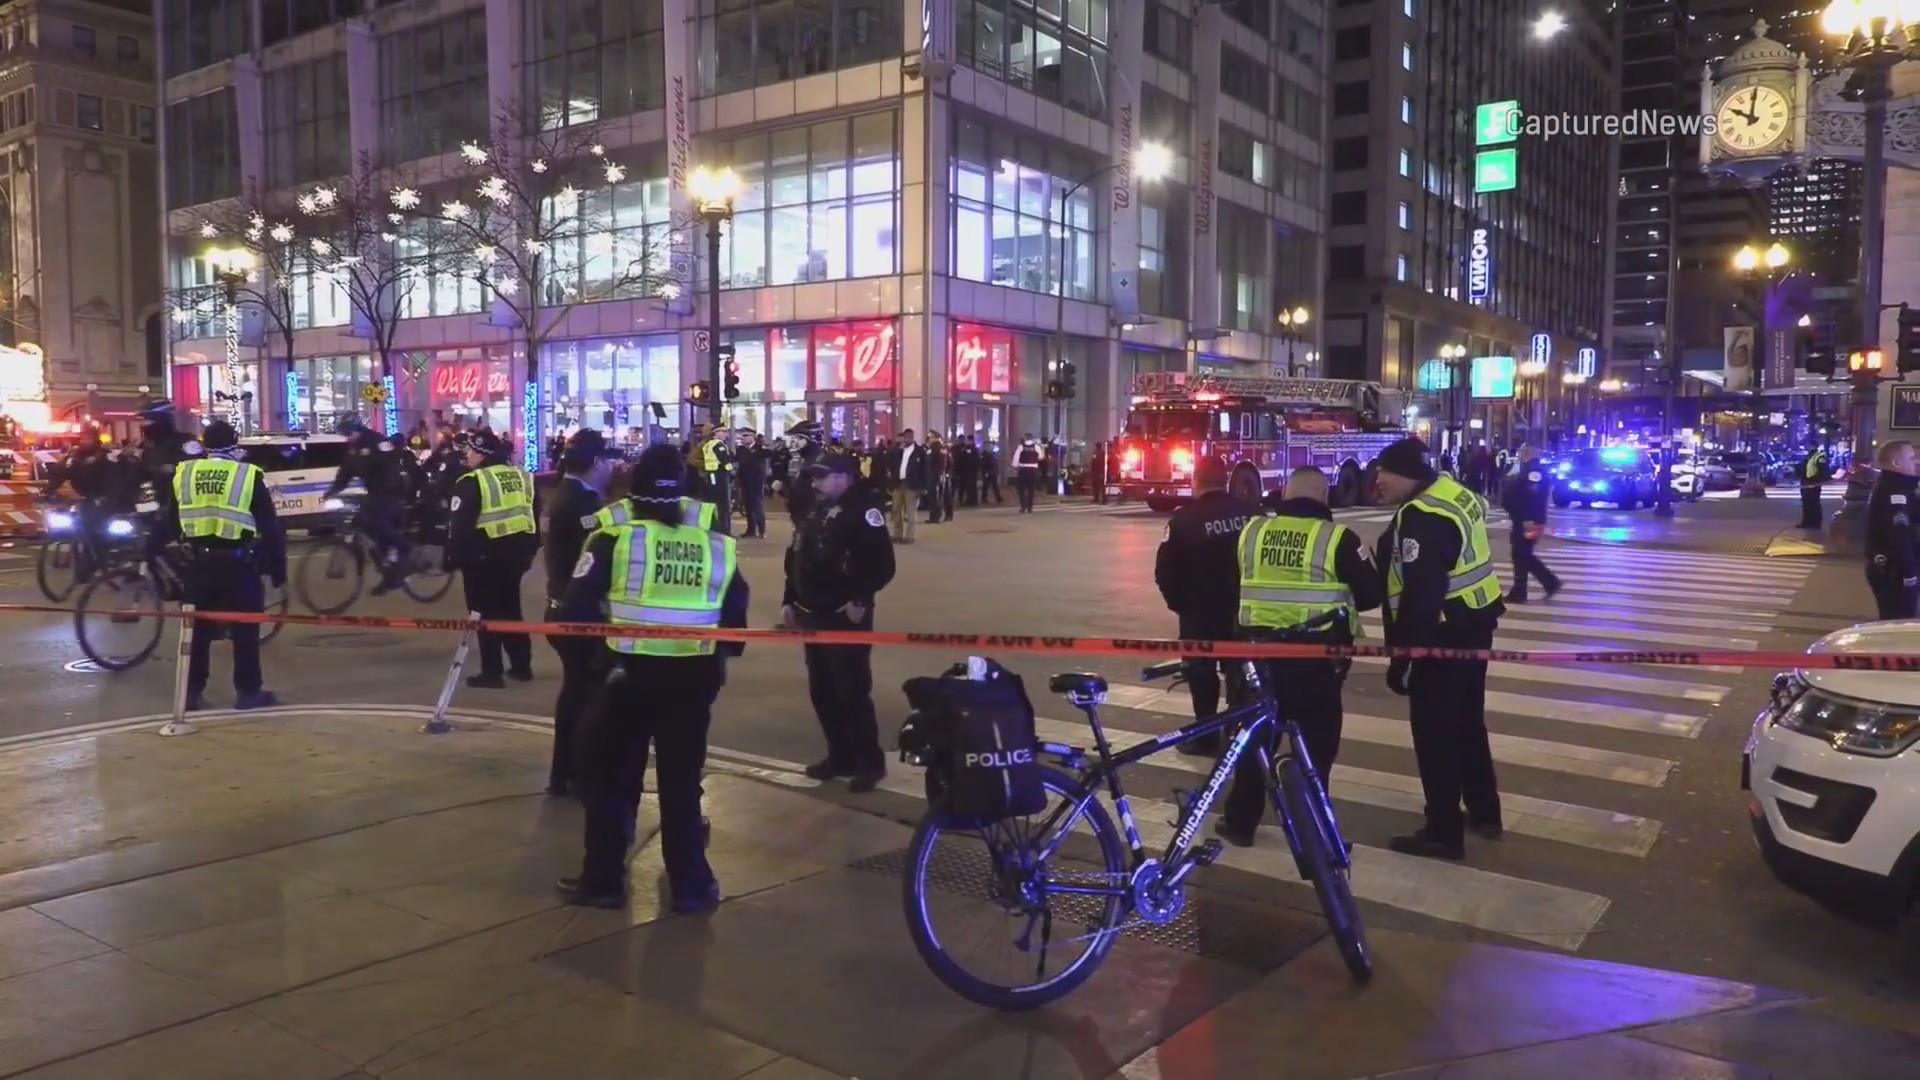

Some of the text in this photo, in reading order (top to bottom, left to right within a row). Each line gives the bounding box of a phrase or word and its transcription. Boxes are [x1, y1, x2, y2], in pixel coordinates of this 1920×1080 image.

[1471, 228, 1488, 291] ROSS
[195, 469, 230, 483] CHICAGO
[195, 482, 226, 496] POLICE
[274, 499, 304, 510] CAGO
[1204, 516, 1248, 536] POLICE
[1262, 529, 1309, 549] CHICAGO
[655, 540, 704, 563] CHICAGO
[1260, 547, 1305, 568] POLICE
[654, 563, 704, 587] POLICE
[1832, 655, 1920, 671] NTER
[965, 748, 1033, 768] POLICE
[1175, 742, 1242, 849] CHICAGO POLICE
